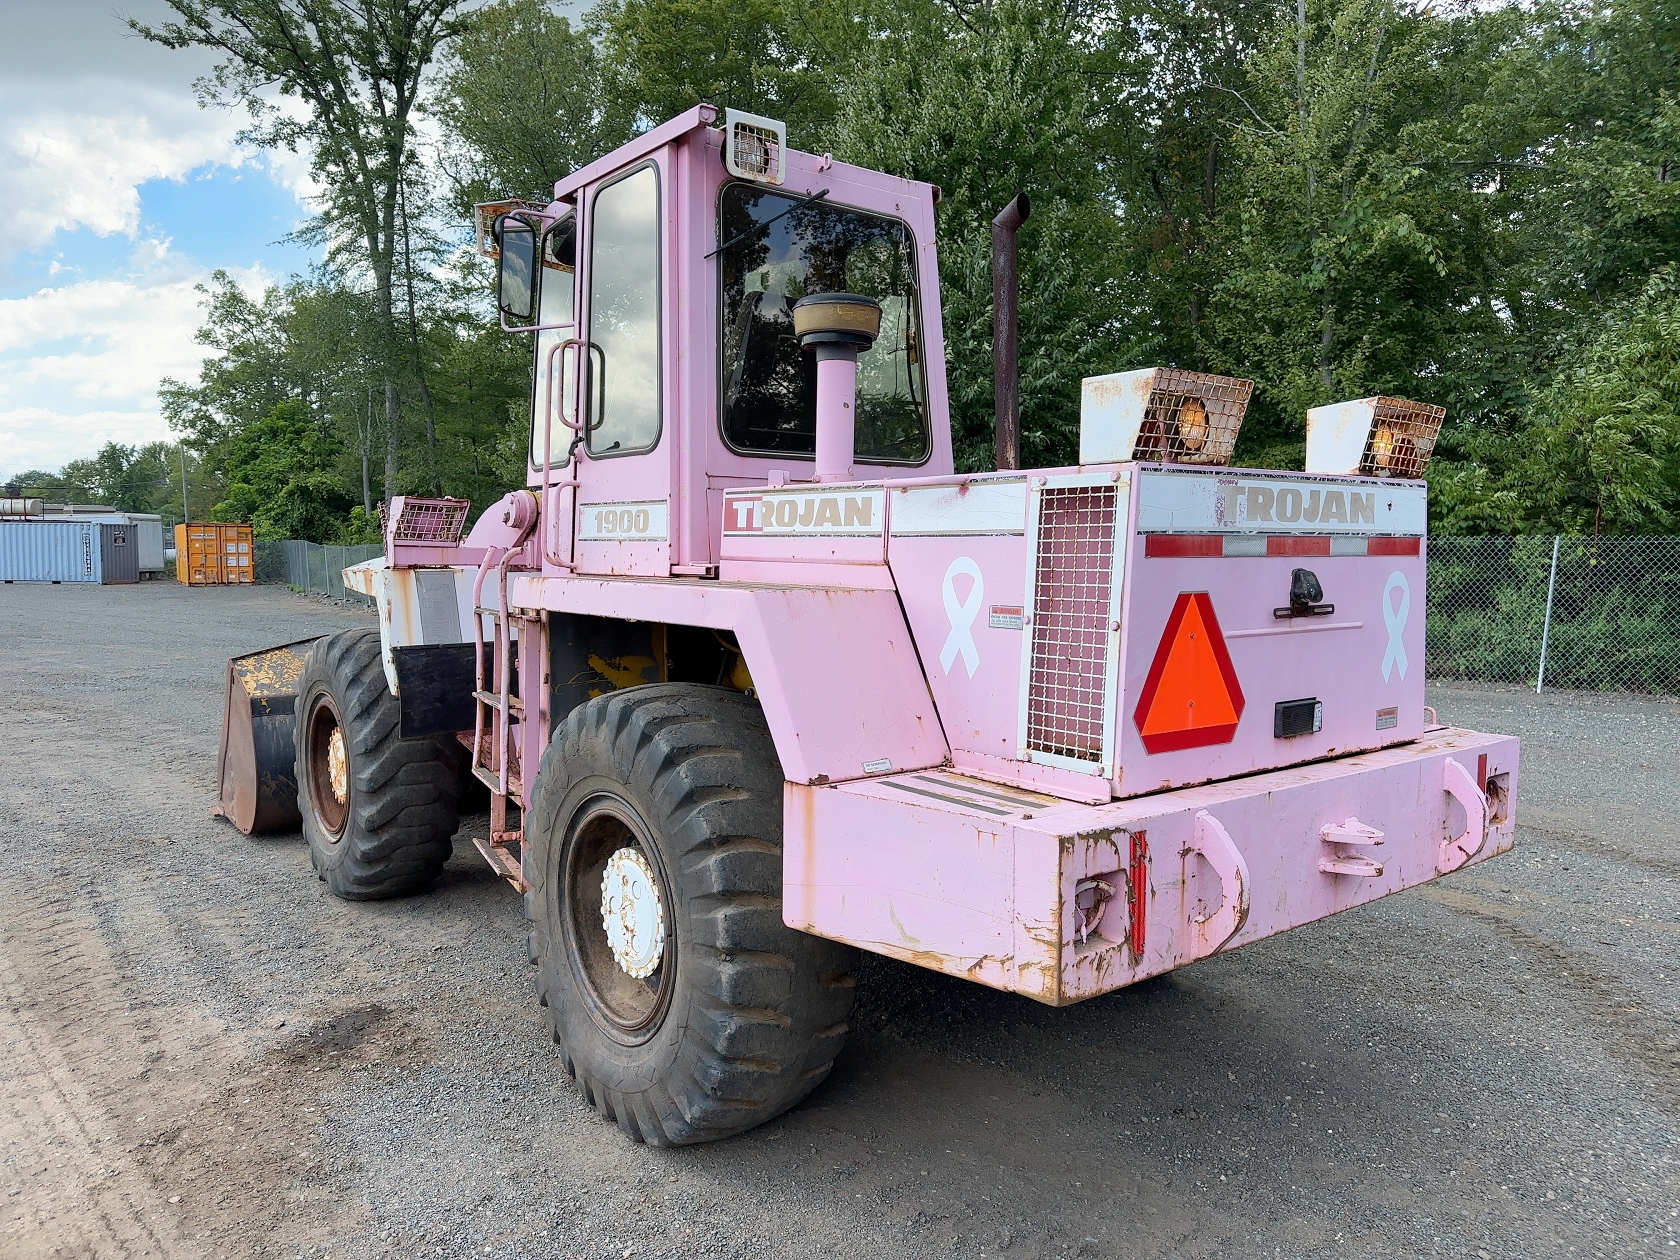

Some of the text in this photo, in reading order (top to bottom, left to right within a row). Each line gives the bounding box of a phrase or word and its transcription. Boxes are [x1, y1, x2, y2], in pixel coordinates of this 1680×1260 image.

[732, 496, 872, 528] TROJAN
[1217, 485, 1375, 524] TROJAN
[594, 509, 650, 534] 1900
